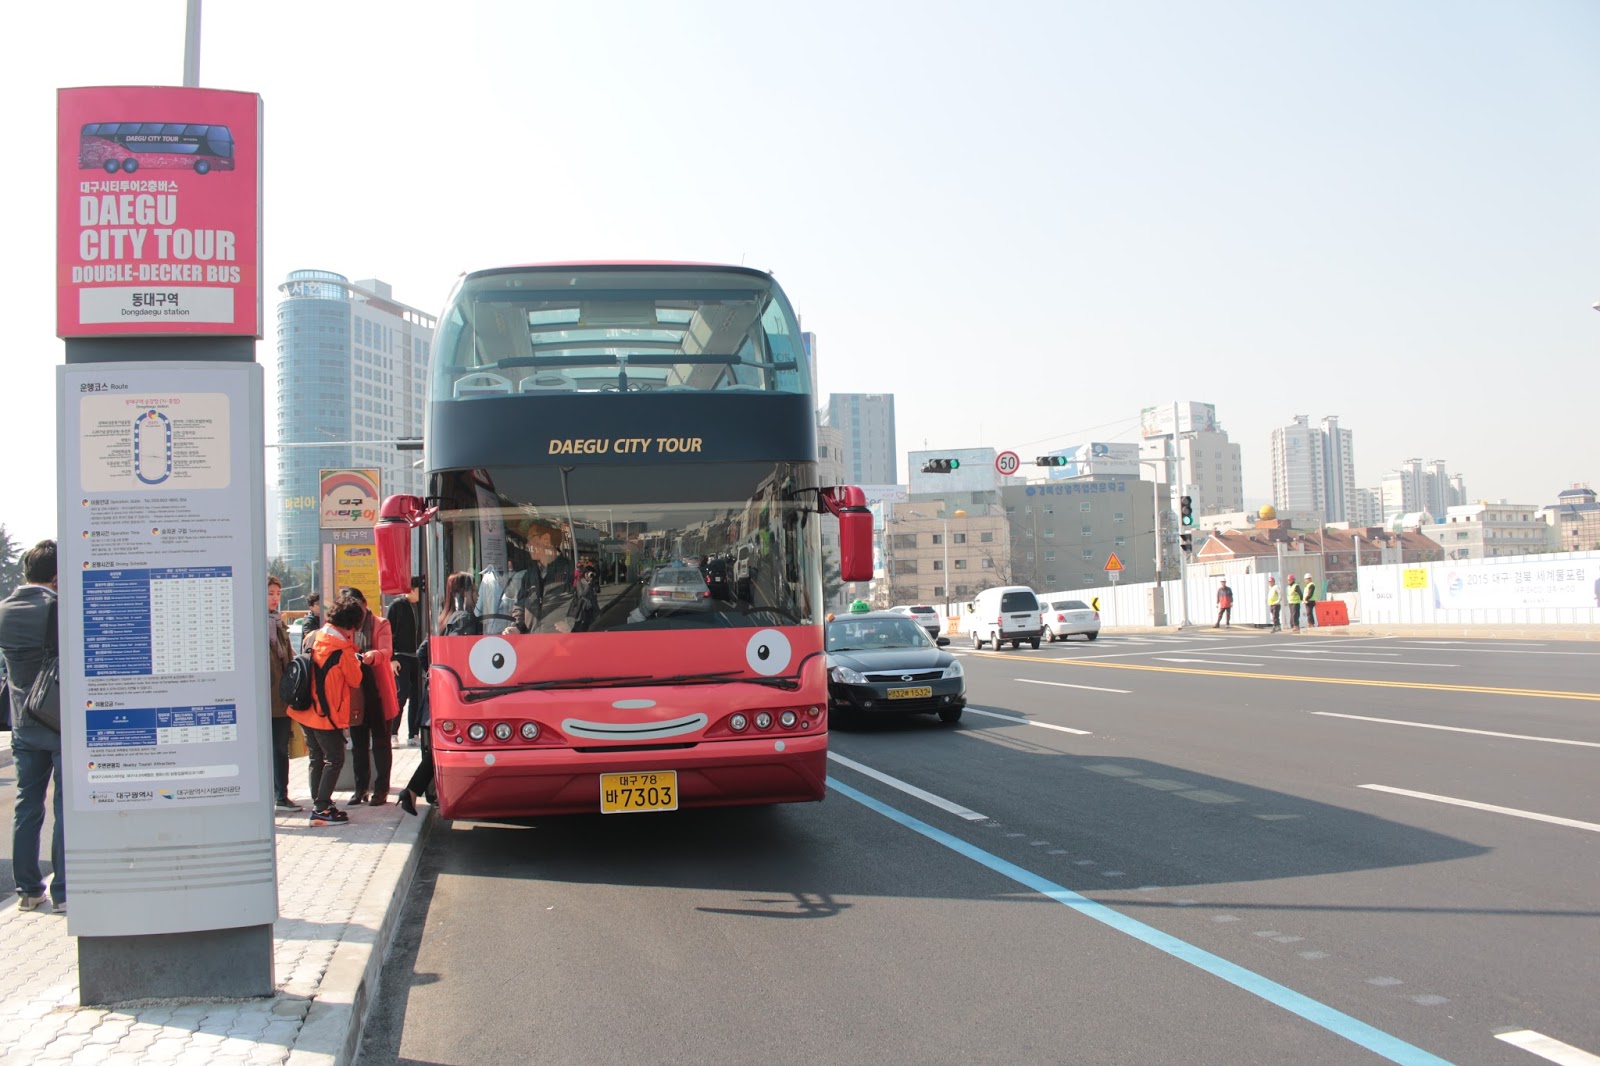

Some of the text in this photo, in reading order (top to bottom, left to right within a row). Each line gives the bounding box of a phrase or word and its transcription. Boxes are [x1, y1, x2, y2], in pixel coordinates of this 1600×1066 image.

[80, 180, 178, 193] 대구시티투어2층버스
[80, 194, 177, 226] DAEGU
[79, 228, 235, 261] CITY TOUR
[72, 264, 241, 283] DOUBLE-DECKER BUS
[132, 292, 179, 307] 동대구역
[121, 308, 190, 318] Dongdaegu station
[80, 383, 108, 392] 운행코스
[548, 437, 703, 455] DAEGU CITY TOUR
[1000, 457, 1016, 470] 50
[325, 509, 376, 521] 시티투어
[332, 531, 368, 539] 동대구역
[1467, 574, 1489, 586] 2015
[1536, 568, 1585, 582] 세계물포럼
